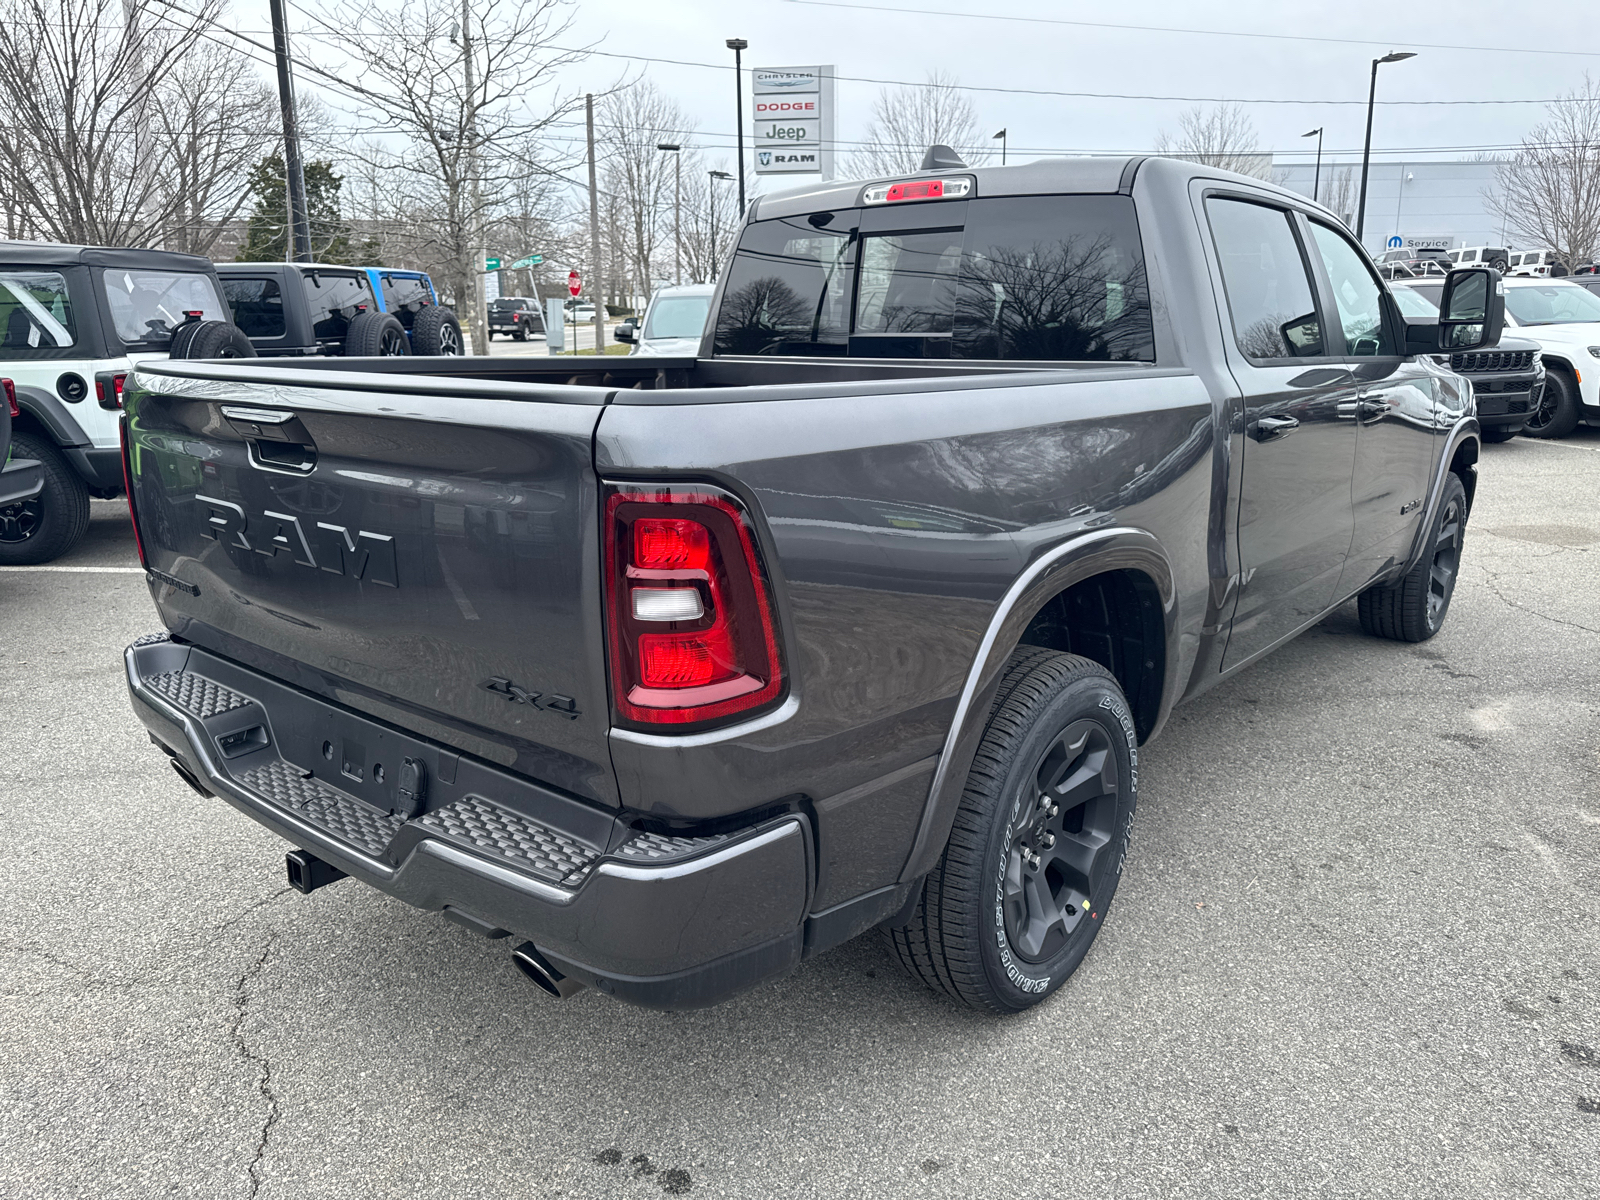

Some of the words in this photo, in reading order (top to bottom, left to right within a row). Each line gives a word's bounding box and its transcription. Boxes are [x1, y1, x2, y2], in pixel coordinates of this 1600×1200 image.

[757, 102, 815, 111] DODGE
[766, 124, 806, 141] Jeep
[774, 155, 815, 163] RAM
[1407, 239, 1449, 248] Service
[195, 494, 399, 589] RAM
[995, 795, 1051, 993] BRIDGESTONE
